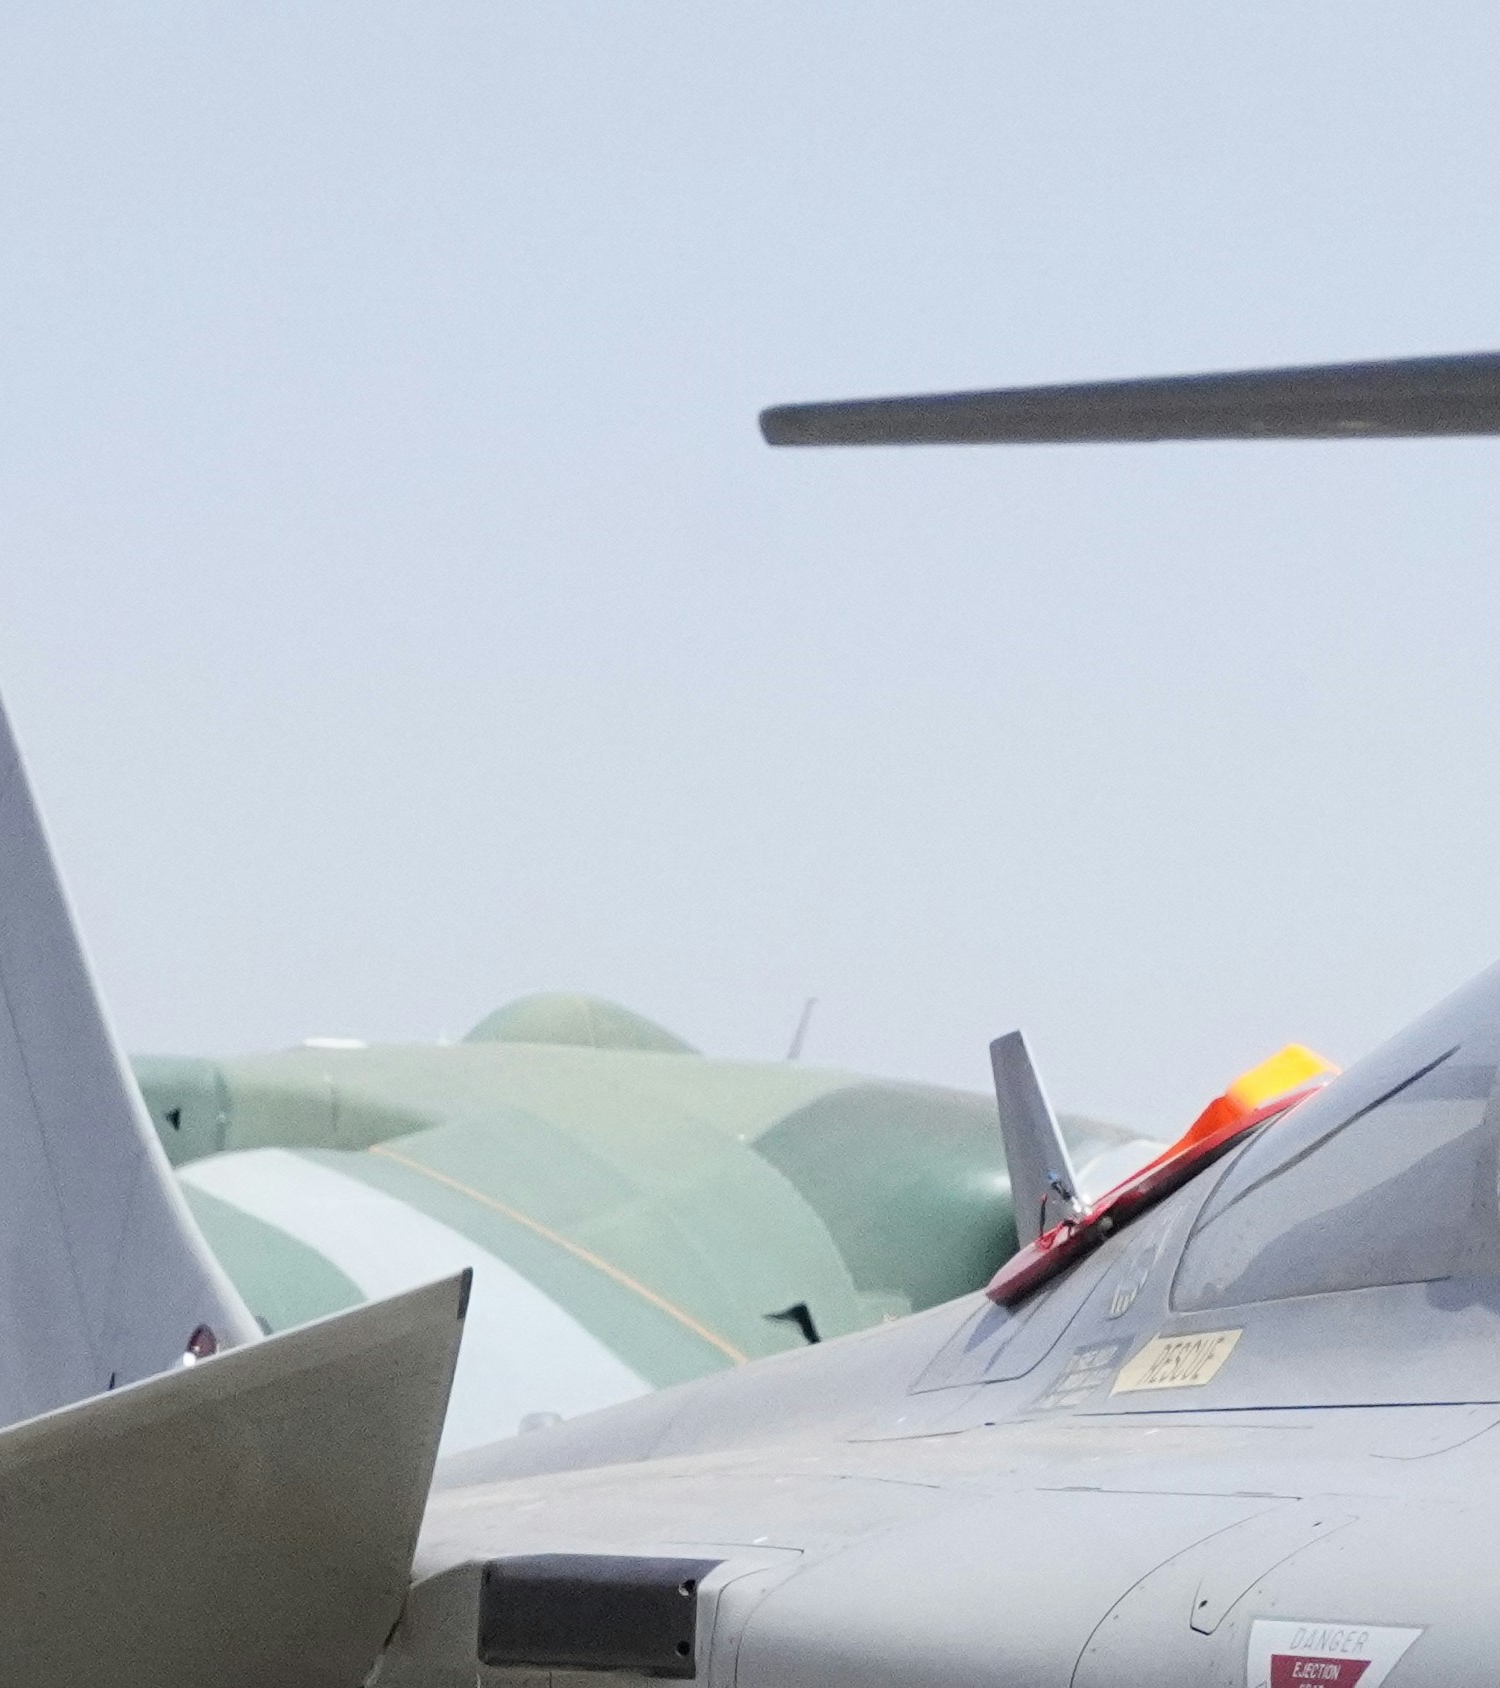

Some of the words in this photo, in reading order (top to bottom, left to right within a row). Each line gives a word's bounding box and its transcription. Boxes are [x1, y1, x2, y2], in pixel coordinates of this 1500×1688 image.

[1138, 1336, 1225, 1384] RESCUE
[1291, 1628, 1369, 1653] DANGER
[1292, 1661, 1340, 1680] EJECTION
